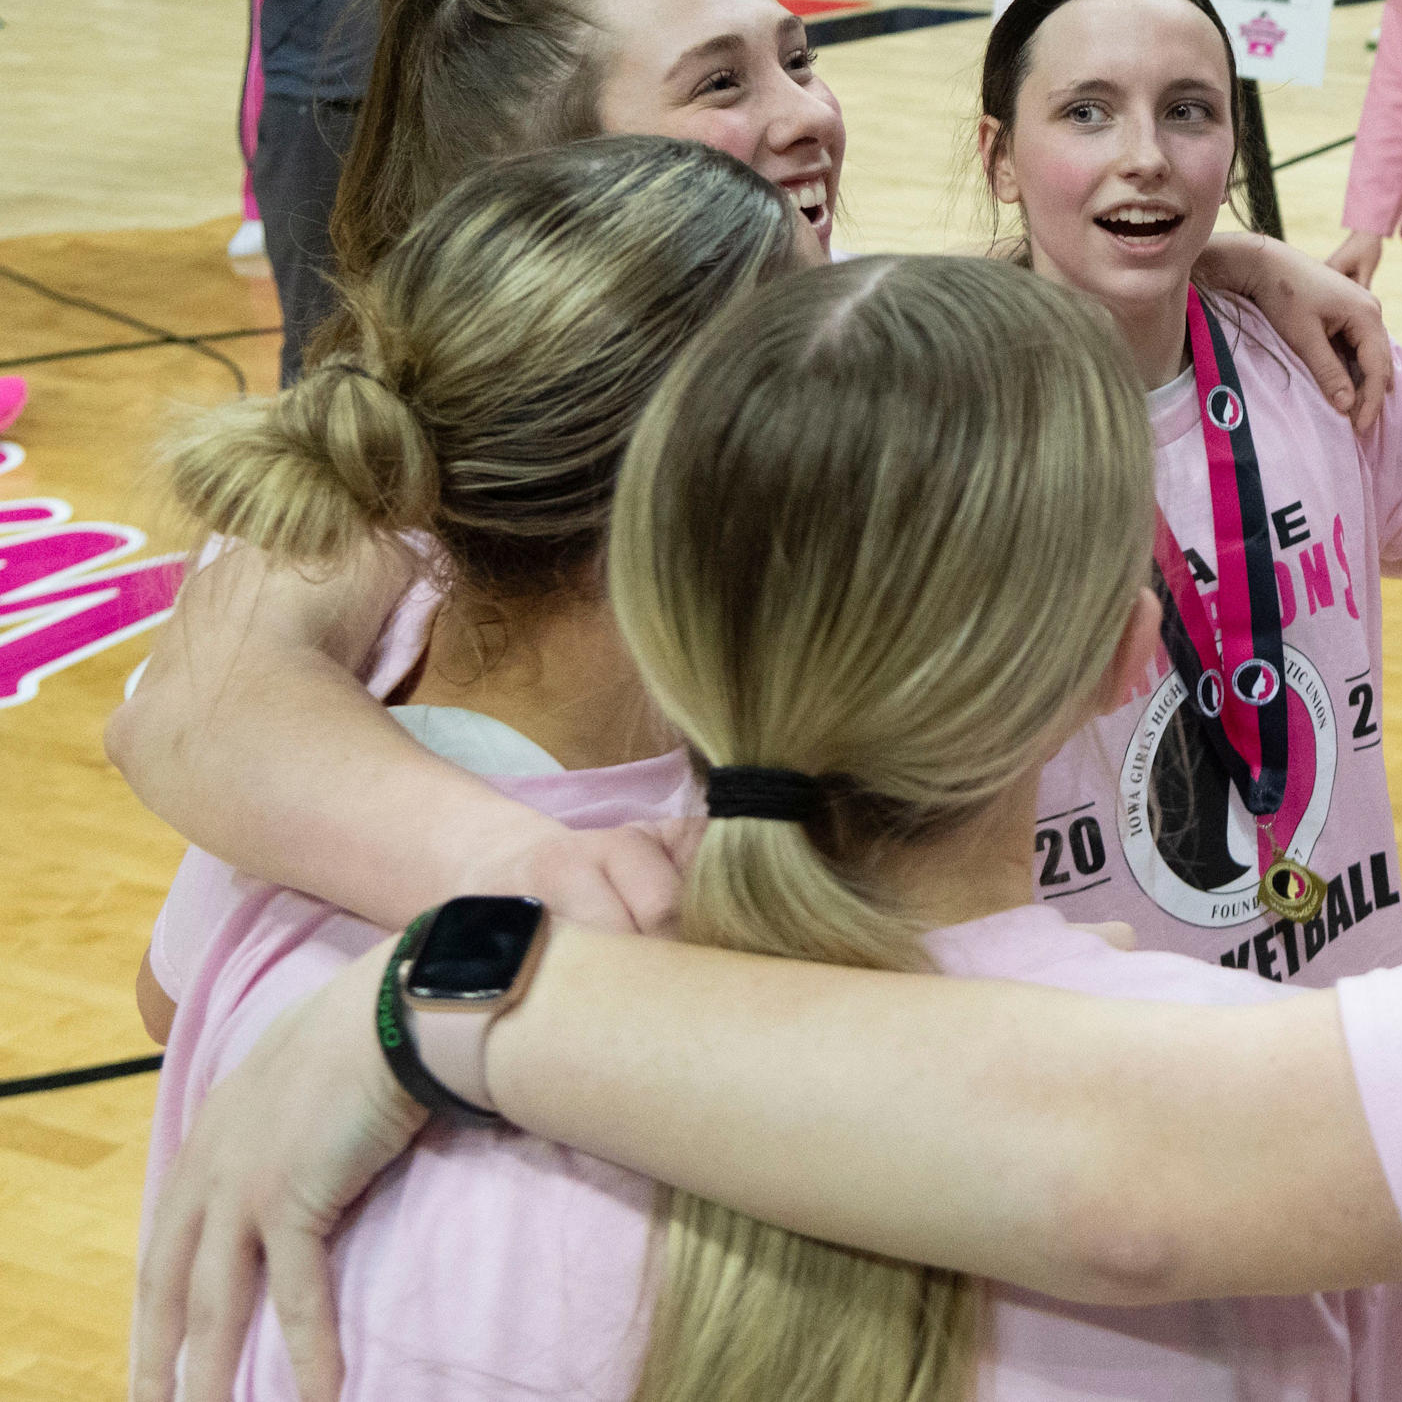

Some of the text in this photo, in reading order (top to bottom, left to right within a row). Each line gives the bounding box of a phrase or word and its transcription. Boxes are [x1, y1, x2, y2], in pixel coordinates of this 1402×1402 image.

[1151, 682, 1184, 728] HIGH
[1304, 680, 1329, 731] UNION
[1035, 815, 1107, 887] 20
